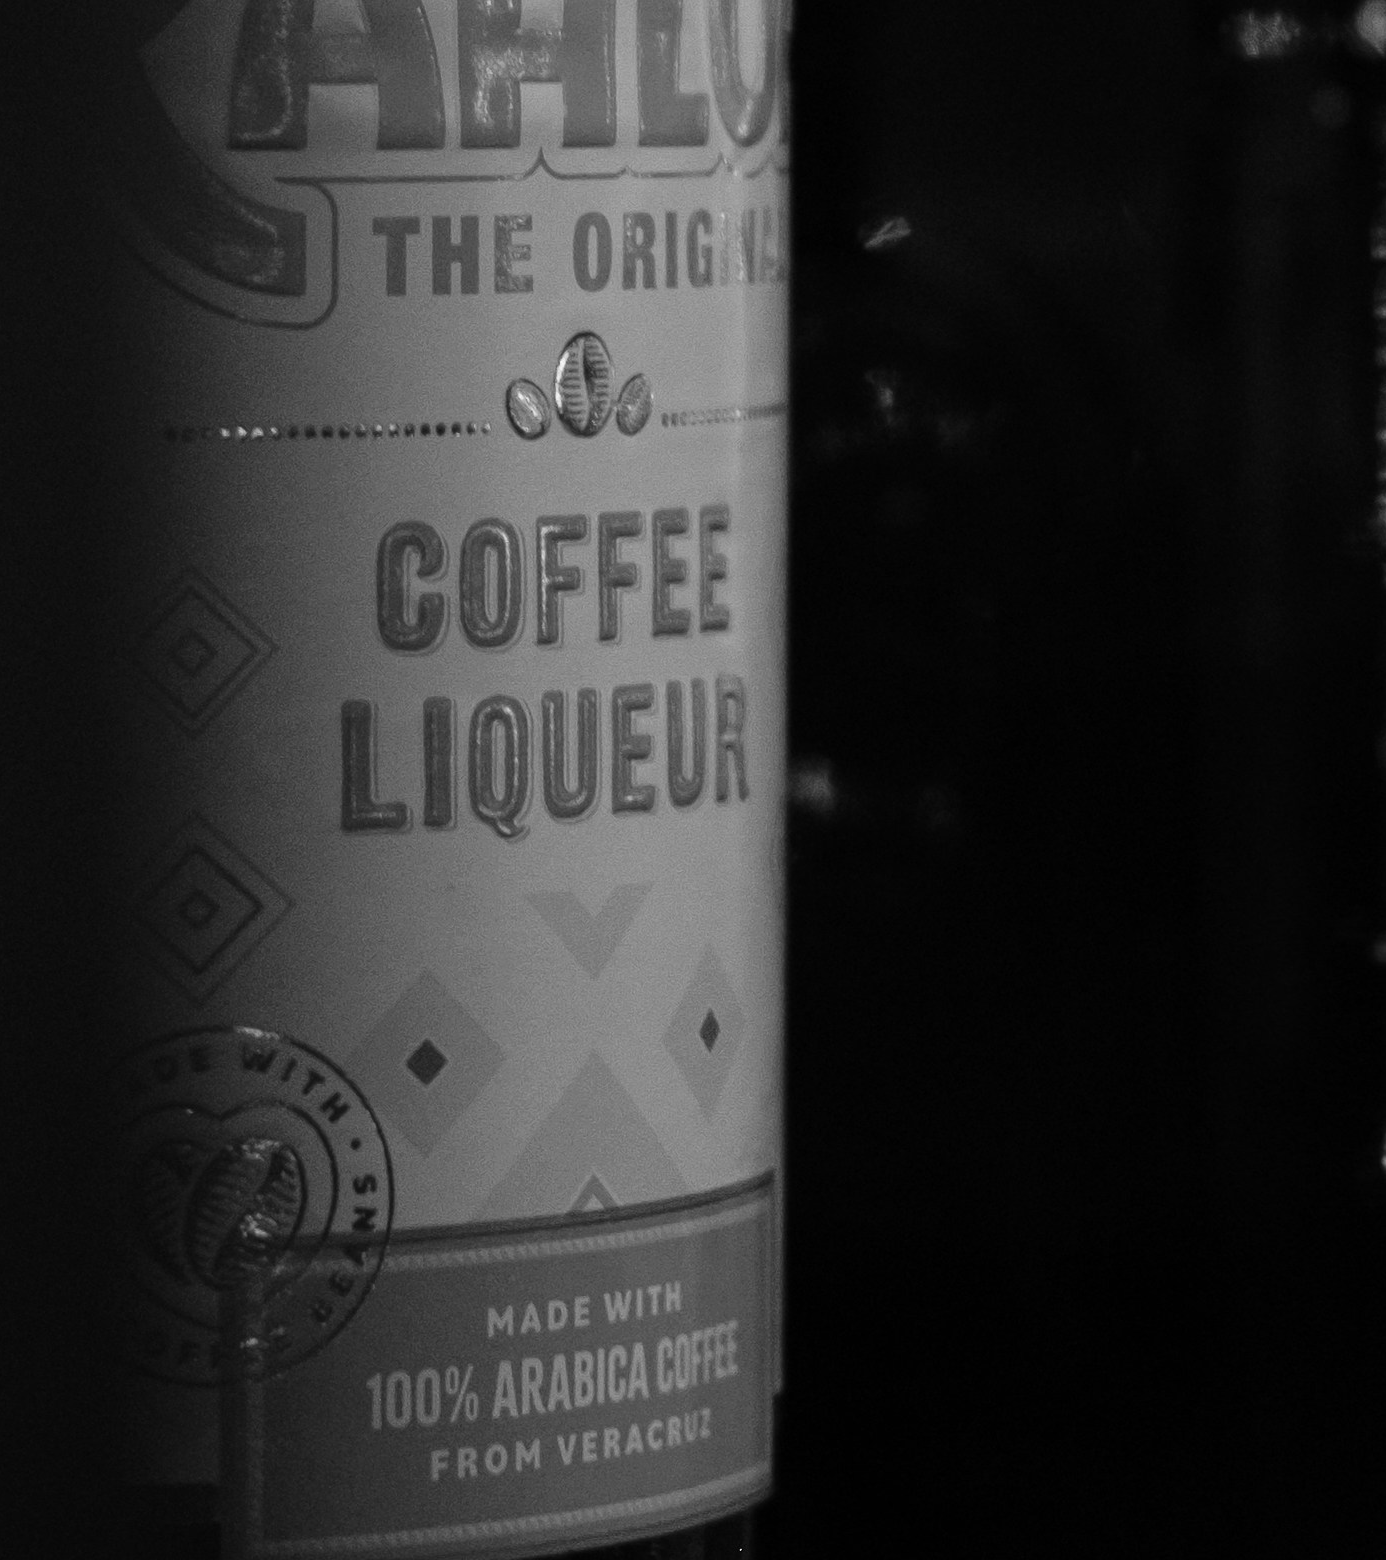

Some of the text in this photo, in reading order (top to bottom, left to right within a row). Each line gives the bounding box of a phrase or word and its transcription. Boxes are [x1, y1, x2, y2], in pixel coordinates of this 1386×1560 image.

[372, 213, 534, 297] THE
[376, 502, 730, 651] COFFEE
[339, 677, 750, 839] LIQUEUR
[242, 1044, 351, 1123] WITH
[486, 1280, 683, 1338] MADE WITH
[366, 1320, 740, 1431] 100% ARABICA COFFEE
[429, 1407, 712, 1482] FROM VERACRUZ
